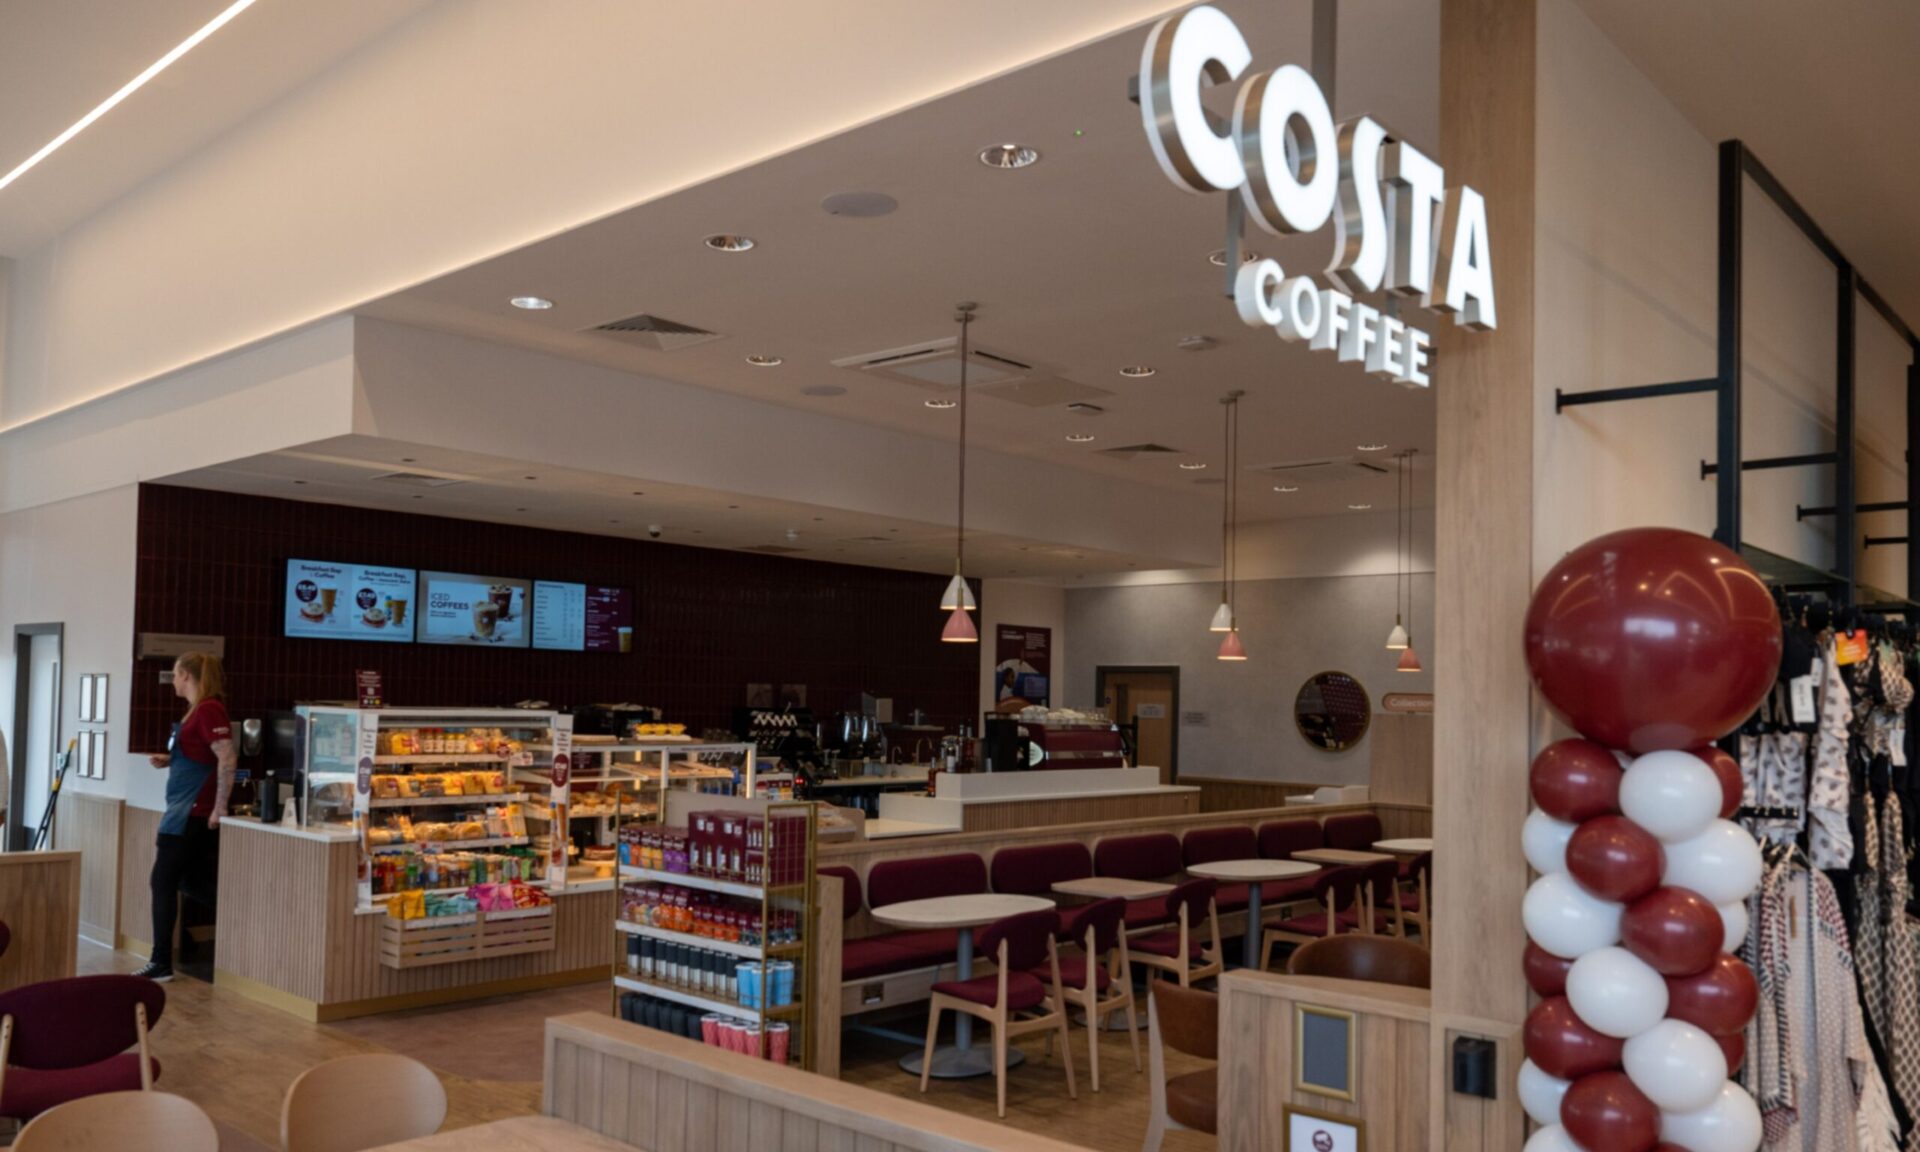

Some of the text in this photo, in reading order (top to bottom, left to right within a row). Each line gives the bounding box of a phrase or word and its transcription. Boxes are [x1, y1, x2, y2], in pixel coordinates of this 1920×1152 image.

[1141, 5, 1497, 332] COSTA
[1235, 258, 1430, 387] COFFEE
[364, 569, 392, 577] Breakfast
[431, 592, 450, 601] ICED
[430, 600, 469, 610] COFFEES
